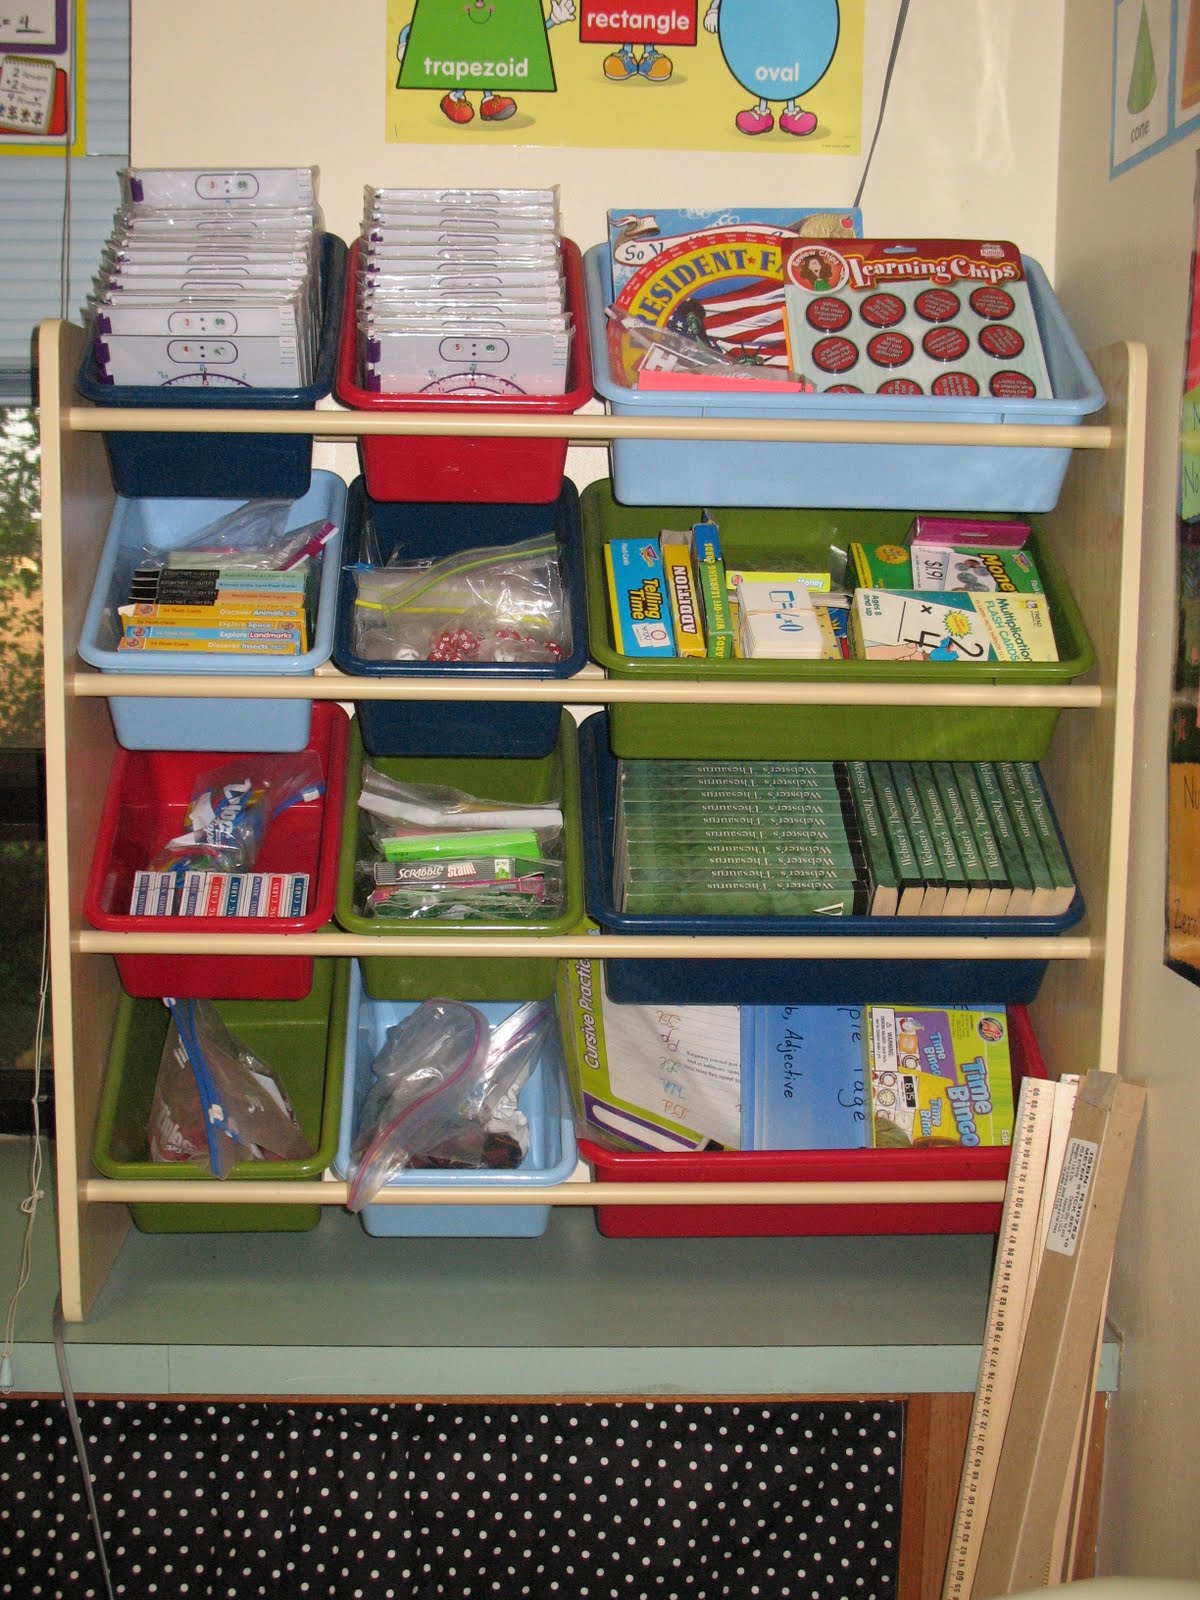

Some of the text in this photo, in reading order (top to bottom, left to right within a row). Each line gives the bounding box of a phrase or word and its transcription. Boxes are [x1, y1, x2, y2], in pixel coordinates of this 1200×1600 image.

[586, 8, 691, 33] rectangle
[424, 56, 529, 80] trapezoid
[754, 62, 800, 82] oval
[1130, 119, 1149, 143] cone
[625, 244, 644, 261] So
[792, 250, 839, 268] Review Chips
[849, 257, 1015, 288] Learning Chips
[708, 564, 721, 599] LEARNING
[925, 560, 943, 581] $1.91
[979, 553, 1018, 592] Mone
[629, 590, 645, 620] Time
[642, 579, 662, 619] Telling
[672, 566, 697, 633] ADDITION
[864, 594, 873, 616] and up
[872, 594, 880, 611] Ages
[220, 608, 252, 616] Discover
[253, 608, 284, 617] Animals
[714, 598, 726, 630] WIPE-OFF
[1034, 610, 1043, 627] TREND
[220, 631, 293, 639] Explore Landmarks
[985, 600, 1020, 661] FLASH CARDS
[996, 598, 1032, 661] Multiplication
[716, 635, 726, 658] ARDS
[697, 766, 817, 775] Webster's Thesaurus
[698, 779, 818, 787] Webster's Thesaurus
[701, 791, 822, 800] Webster's Thesaurus
[702, 805, 823, 814] Webster's Thesaurus
[863, 799, 878, 837] Thesaurus
[992, 800, 1009, 839] Thesaurus
[1012, 800, 1030, 838] Thesaurus
[1031, 798, 1049, 837] Thesaurus
[703, 816, 825, 826] Webster's Thesaurus
[884, 786, 913, 867] Webster's Thesaurus
[905, 786, 935, 867] Webster's Thesaurus
[927, 788, 956, 869] Webster's Thesaurus
[947, 787, 977, 868] Webster's Thesaurus
[969, 788, 999, 869] Webster's Thesaurus
[706, 830, 829, 839] Webster's Thesaurus
[708, 845, 832, 854] Webster's Thesaurus
[398, 864, 444, 881] SCRABBLE
[710, 857, 835, 866] Webster's Thesaurus
[712, 870, 838, 879] Webster's Thesaurus
[707, 882, 834, 891] Webster's Thesaurus
[576, 959, 600, 1070] Cursive Practic
[930, 1032, 946, 1060] Time
[776, 1028, 804, 1099] Adjective
[904, 1082, 915, 1101] 6:15
[960, 1055, 992, 1116] Time
[920, 1110, 931, 1137] Bing
[929, 1098, 942, 1127] Time
[946, 1083, 980, 1147] Bingo
[1080, 1148, 1090, 1181] METER
[1082, 1152, 1094, 1188] ISBN:
[1016, 1198, 1024, 1208] 90
[1071, 1184, 1081, 1212] STICK
[1063, 1238, 1070, 1248] 10
[996, 1322, 1004, 1331] 80
[994, 1334, 1001, 1343] 79
[986, 1384, 993, 1392] 75
[982, 1409, 989, 1417] 73
[976, 1446, 984, 1456] 70
[972, 1471, 979, 1480] 68
[970, 1484, 977, 1492] 67
[967, 1509, 974, 1517] 65
[960, 1546, 968, 1555] 62
[956, 1571, 965, 1581] 60
